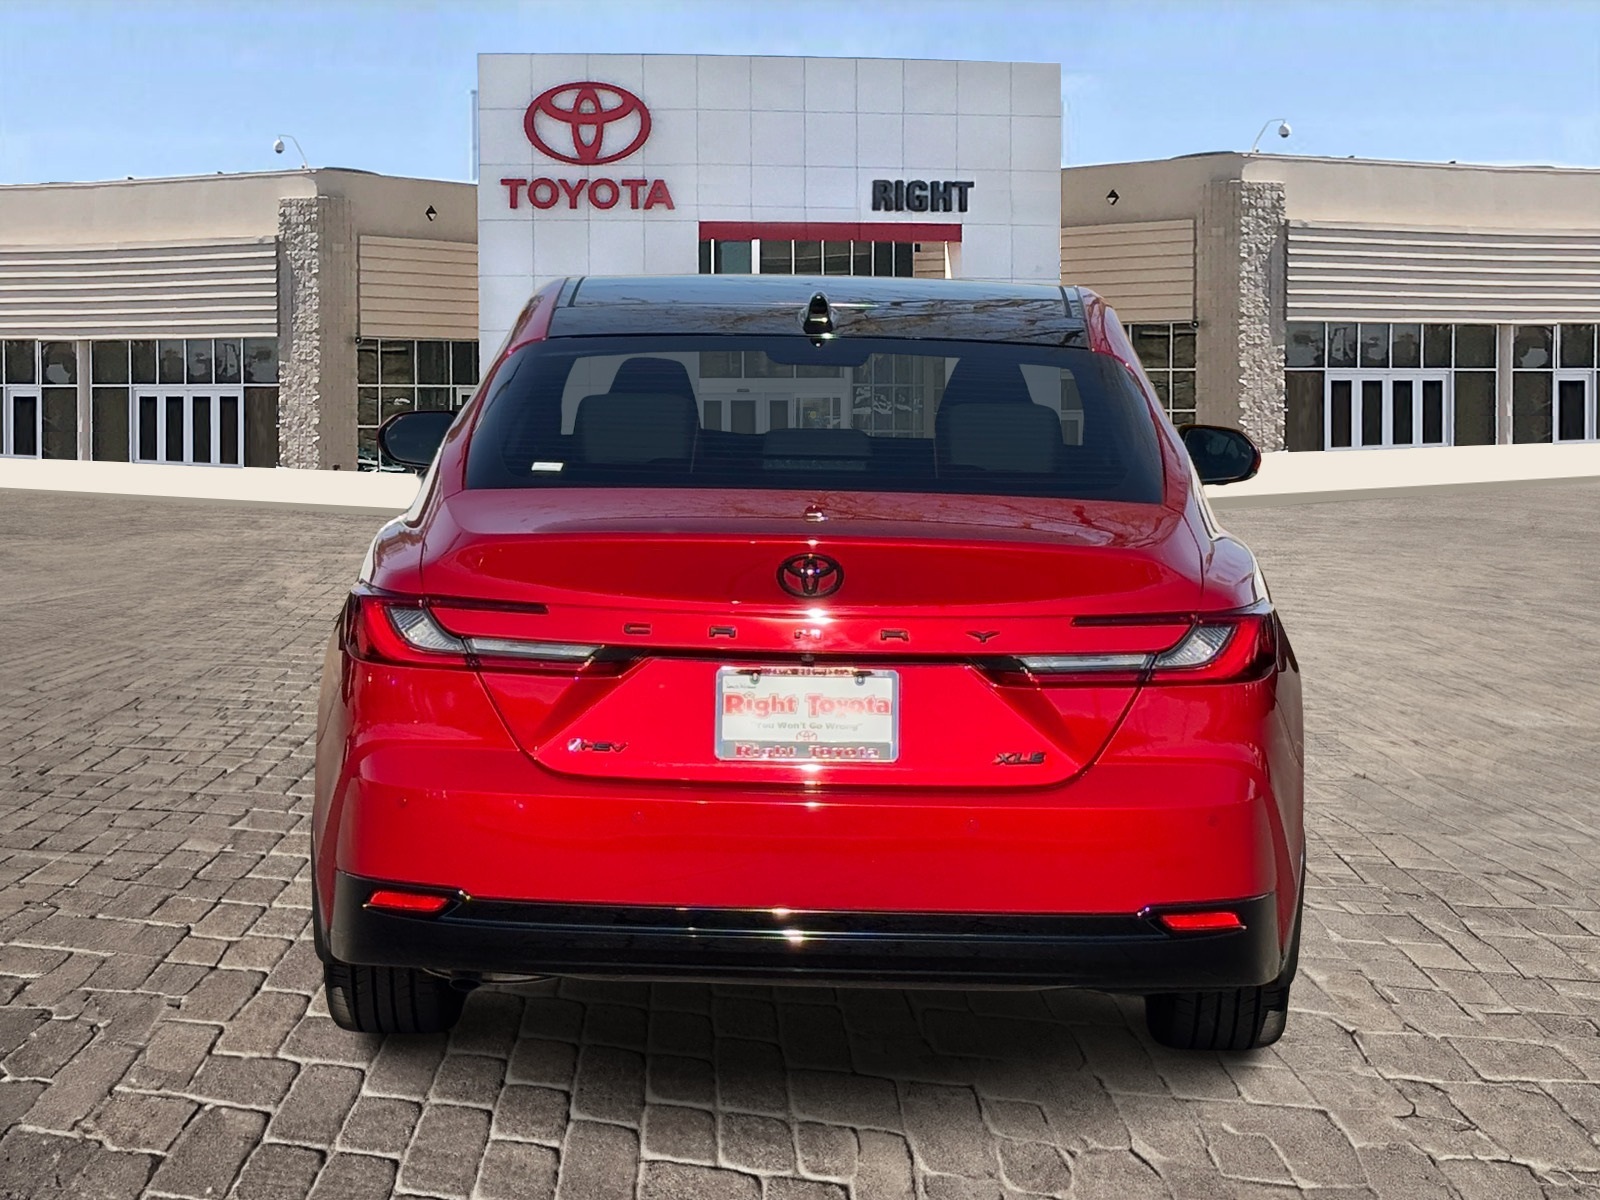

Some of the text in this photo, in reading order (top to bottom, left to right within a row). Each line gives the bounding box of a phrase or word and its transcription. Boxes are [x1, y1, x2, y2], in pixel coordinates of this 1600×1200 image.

[500, 178, 675, 210] TOYOTA
[872, 179, 975, 213] RIGHT
[723, 691, 892, 718] Right Toyota
[777, 721, 807, 729] Won't
[735, 743, 880, 759] Right Toyota
[992, 752, 1046, 764] XLE
